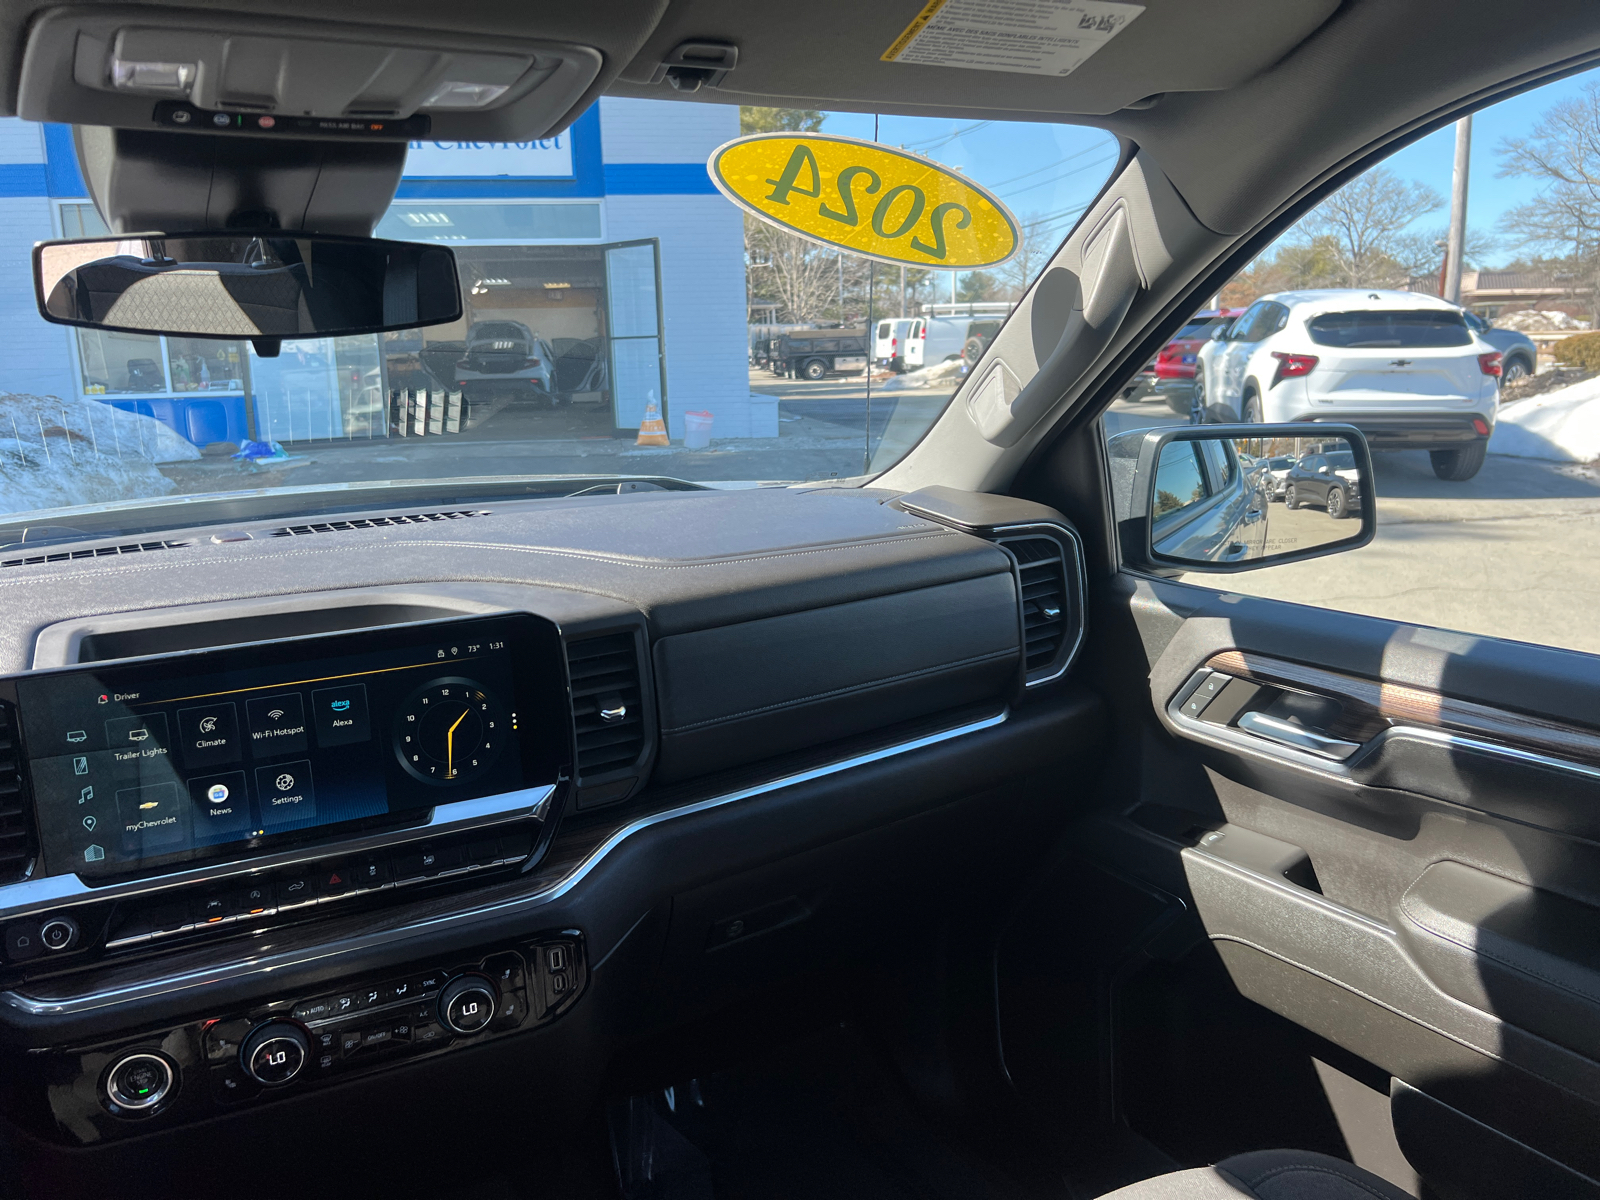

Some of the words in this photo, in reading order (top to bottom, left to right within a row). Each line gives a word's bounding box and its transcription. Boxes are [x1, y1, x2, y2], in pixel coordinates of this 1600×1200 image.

[489, 641, 504, 650] 1:31
[114, 692, 140, 702] Driver
[331, 699, 351, 708] alexa
[332, 719, 353, 728] Alexa
[252, 730, 273, 740] Wi-Fi
[273, 726, 305, 737] Hotspot
[196, 738, 226, 749] Climate
[405, 735, 411, 743] 9
[114, 751, 141, 761] Trailer
[141, 747, 168, 758] Lights
[272, 795, 303, 806] Settings
[210, 807, 233, 817] News
[126, 816, 177, 832] myChevrolet
[422, 978, 437, 987] SYNC
[310, 1005, 325, 1014] AUTO
